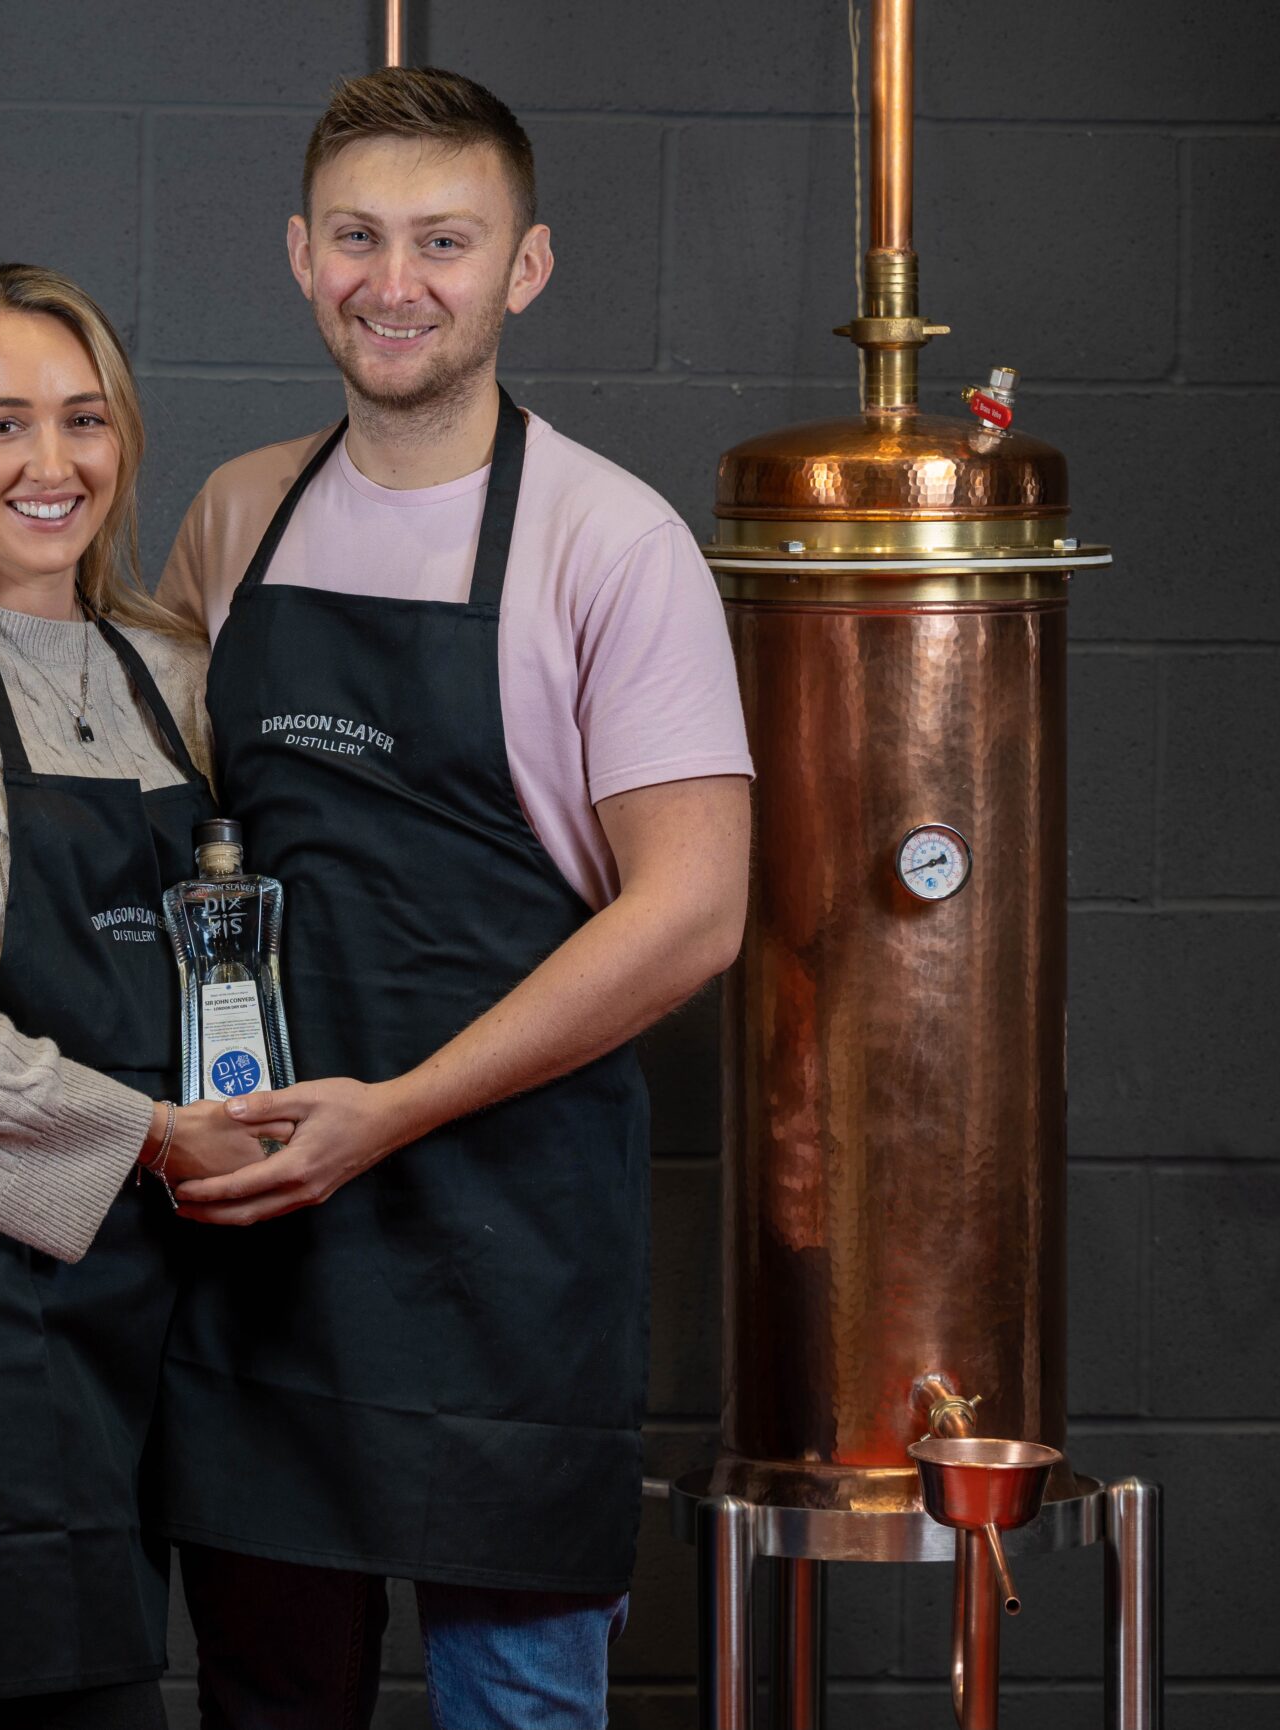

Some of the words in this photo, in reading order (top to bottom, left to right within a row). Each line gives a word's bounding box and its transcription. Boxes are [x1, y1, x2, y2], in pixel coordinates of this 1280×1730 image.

[261, 714, 333, 734] DRAGON
[335, 718, 395, 753] SLAYER
[285, 734, 365, 756] DISTILLERY
[225, 882, 256, 893] SLAYER
[91, 907, 135, 931] DRAGON
[113, 930, 156, 941] DISTILLERY
[214, 998, 229, 1006] JOHN
[230, 996, 256, 1004] CONYERS
